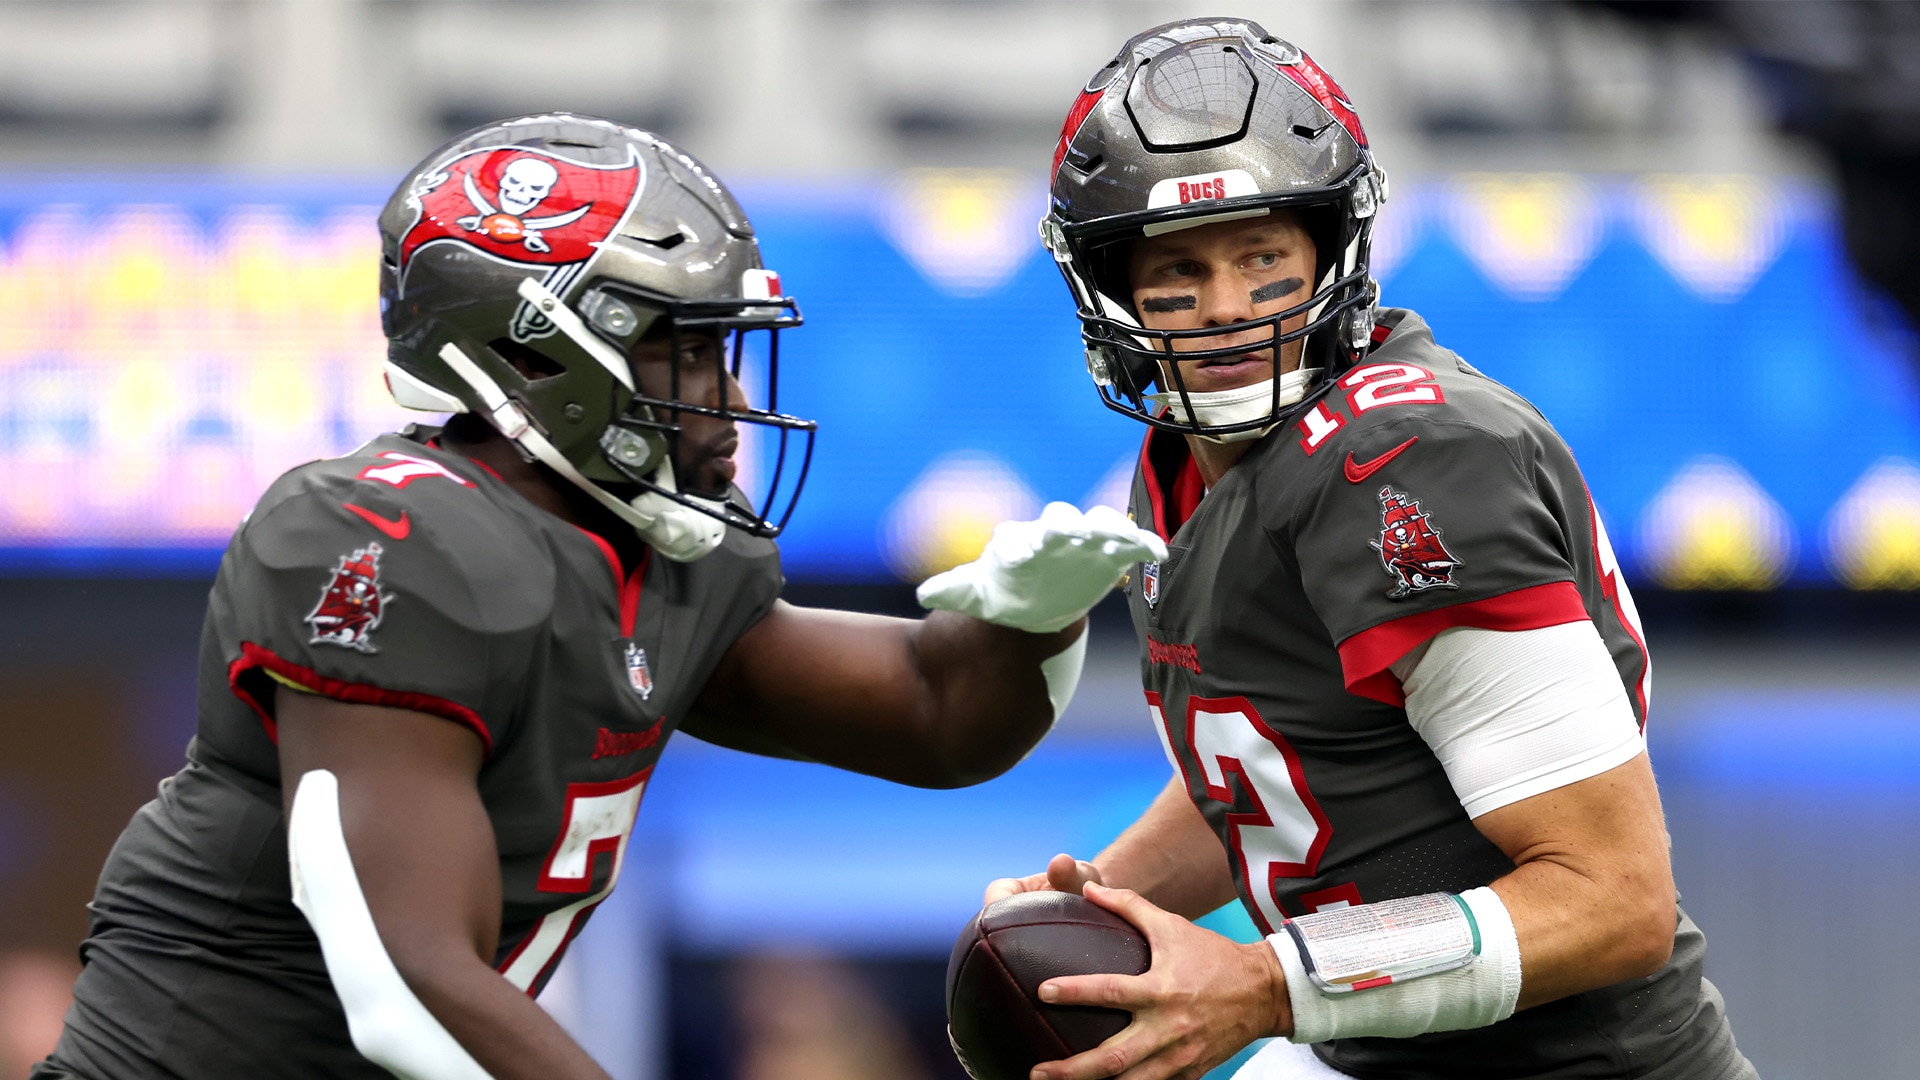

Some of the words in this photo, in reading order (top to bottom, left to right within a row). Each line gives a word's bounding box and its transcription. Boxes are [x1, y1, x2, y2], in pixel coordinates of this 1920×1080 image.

[1293, 363, 1447, 457] 12
[355, 450, 478, 490] 7
[496, 764, 656, 1001] 7
